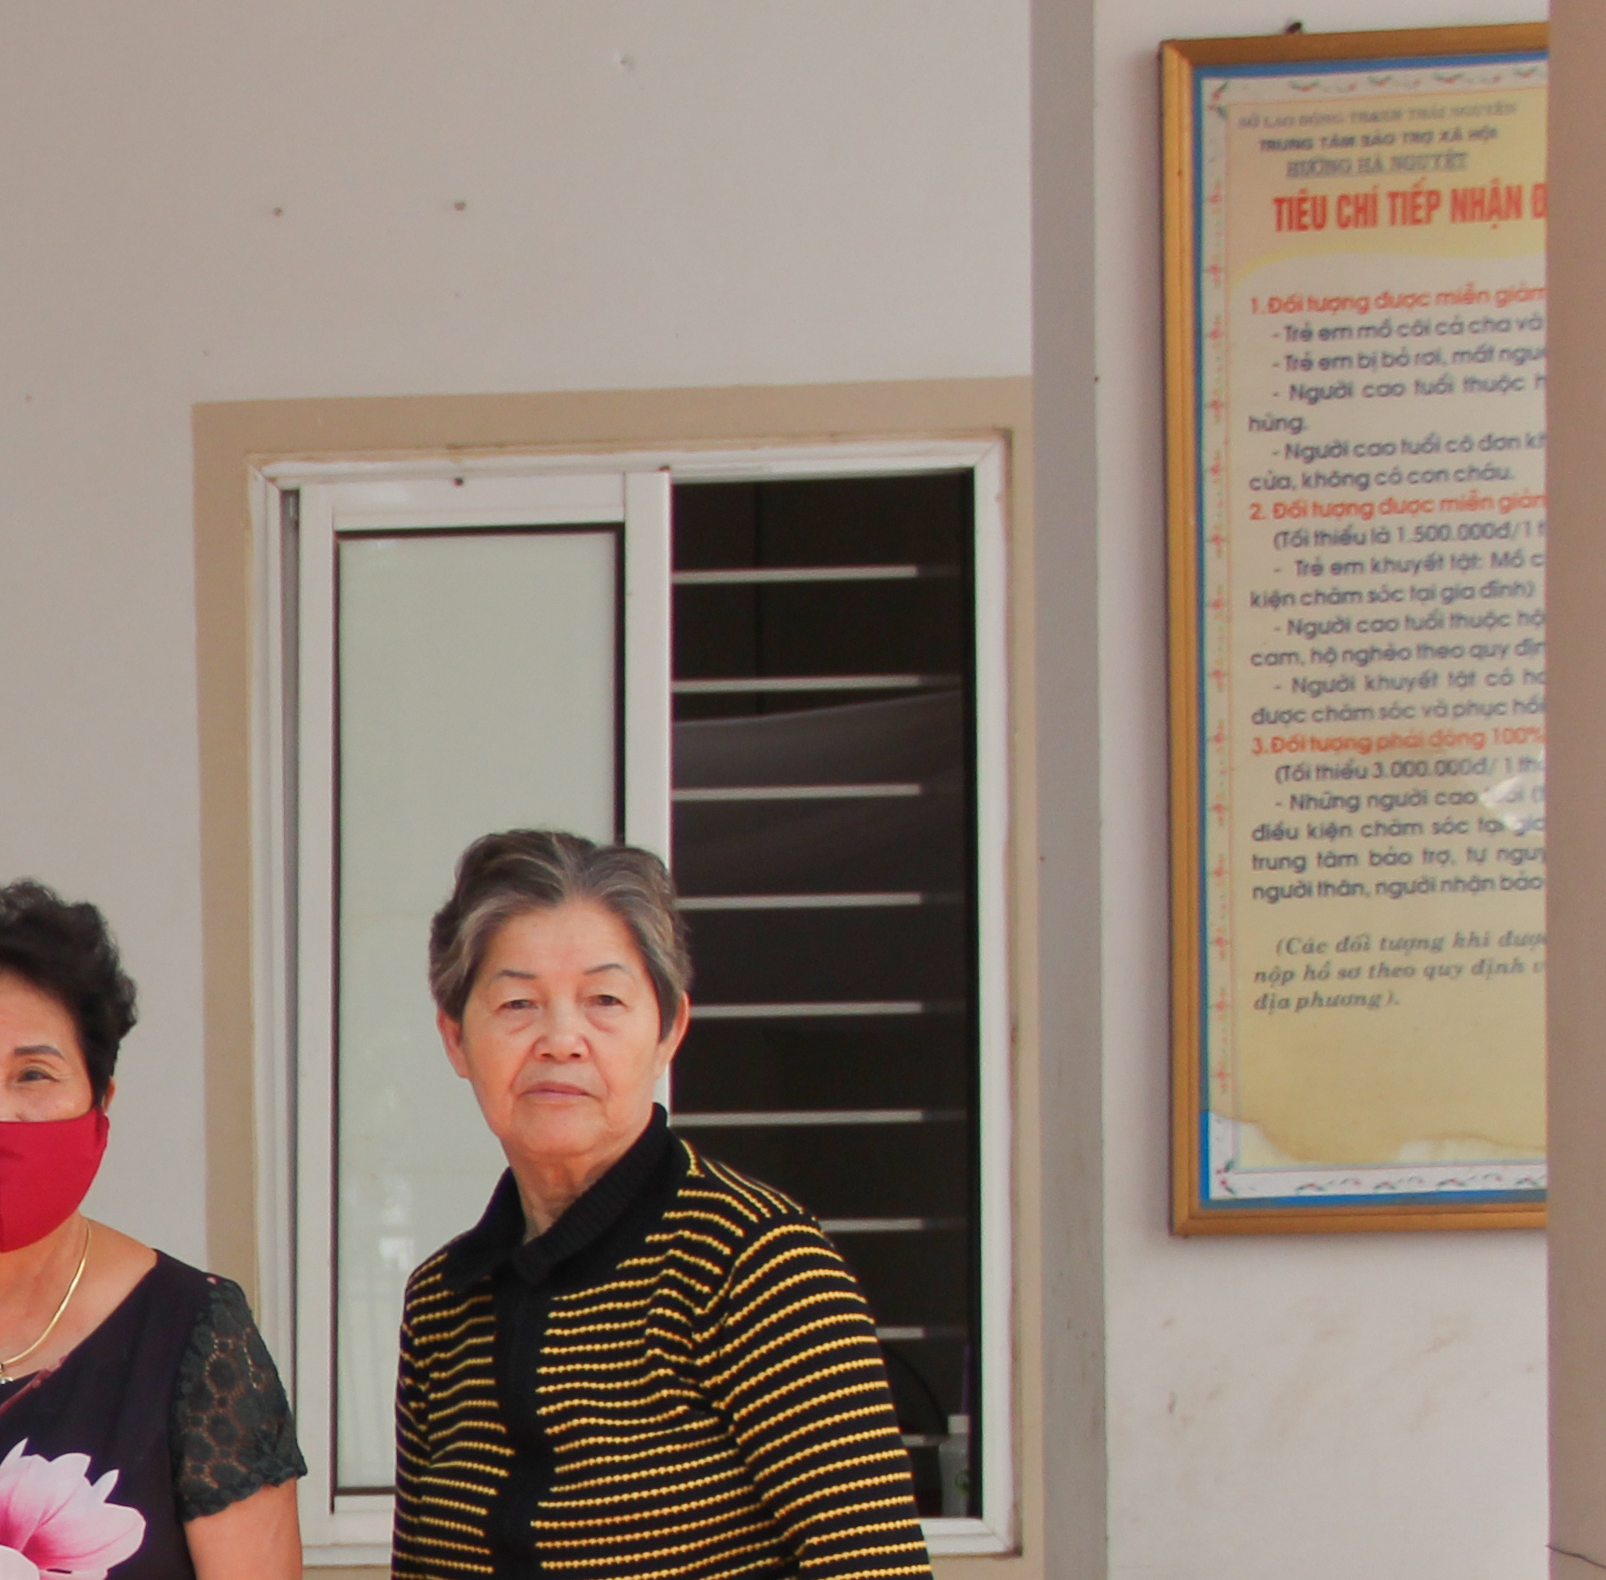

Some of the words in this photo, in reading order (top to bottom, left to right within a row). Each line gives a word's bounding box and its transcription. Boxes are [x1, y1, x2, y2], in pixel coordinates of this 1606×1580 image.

[1260, 136, 1314, 151] TRUNG
[1272, 188, 1328, 233] TIÊU
[1336, 185, 1379, 231] CHÍ
[1387, 176, 1443, 226] TIẾP
[1450, 177, 1523, 230] NHẬN
[1318, 325, 1353, 341] em
[1468, 315, 1512, 334] cha
[1318, 355, 1353, 371] em
[1289, 378, 1354, 406] Người
[1361, 382, 1406, 399] cao
[1284, 439, 1349, 465] Người
[1353, 442, 1396, 458] cao
[1301, 469, 1370, 492] không
[1407, 467, 1449, 485] con
[1371, 524, 1391, 545] là
[1329, 559, 1364, 576] em
[1441, 582, 1476, 605] gia
[1286, 615, 1351, 640] Người
[1356, 617, 1399, 634] cao
[1416, 642, 1464, 661] theo
[1291, 673, 1356, 699] Người
[1434, 788, 1478, 807] cao
[1252, 853, 1307, 873] trung
[1452, 930, 1489, 948] khi
[1368, 960, 1417, 979] theo
[1423, 963, 1463, 982] quy
